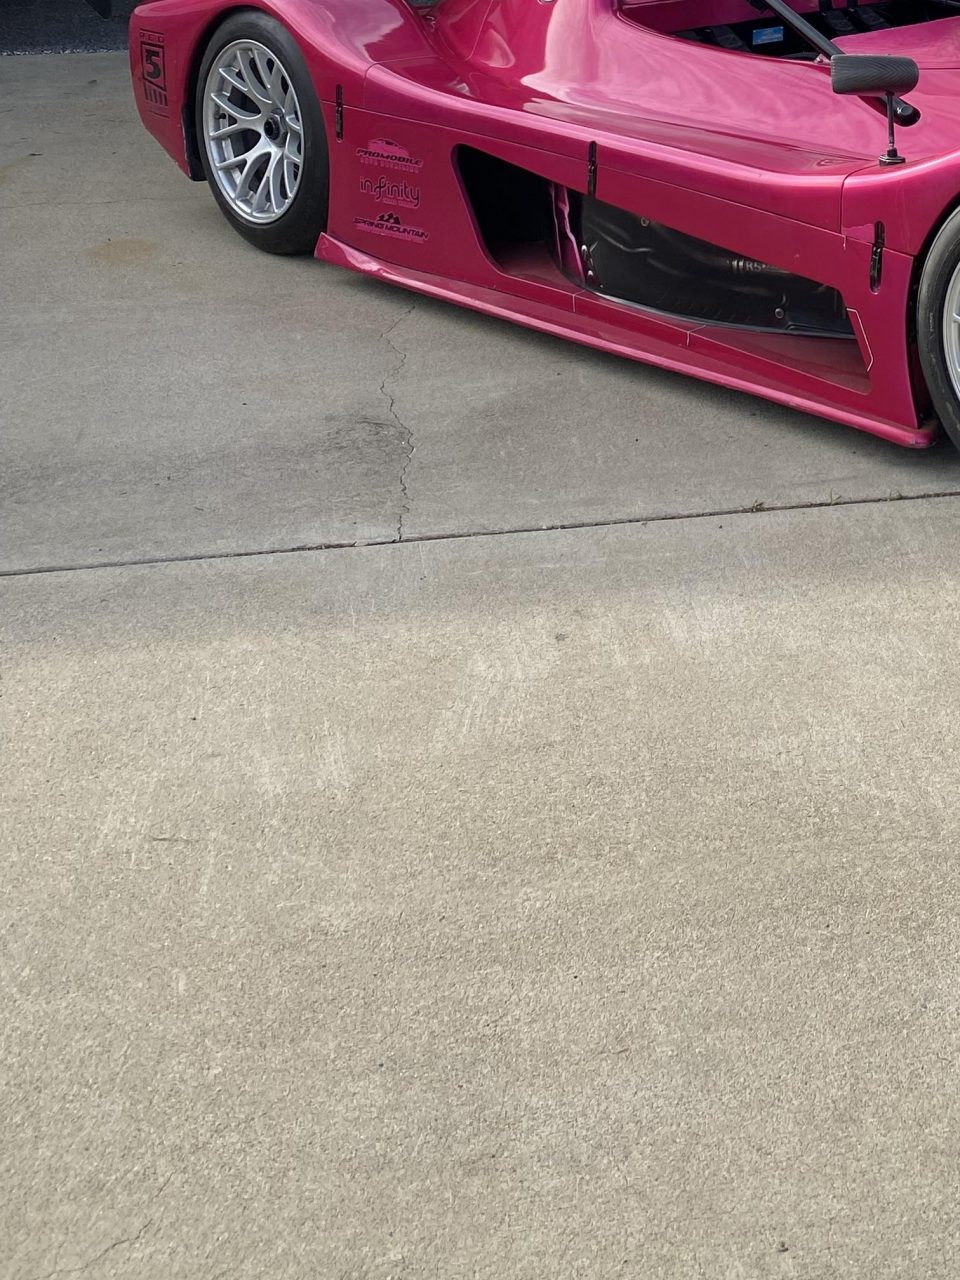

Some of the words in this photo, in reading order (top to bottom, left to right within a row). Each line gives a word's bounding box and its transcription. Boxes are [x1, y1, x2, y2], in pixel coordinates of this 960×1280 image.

[140, 31, 164, 43] RED
[145, 48, 161, 80] 5
[357, 148, 421, 166] PROMOBILE
[360, 176, 420, 208] infinity
[353, 217, 384, 230] SPRING
[384, 223, 429, 239] MOUNTAIN
